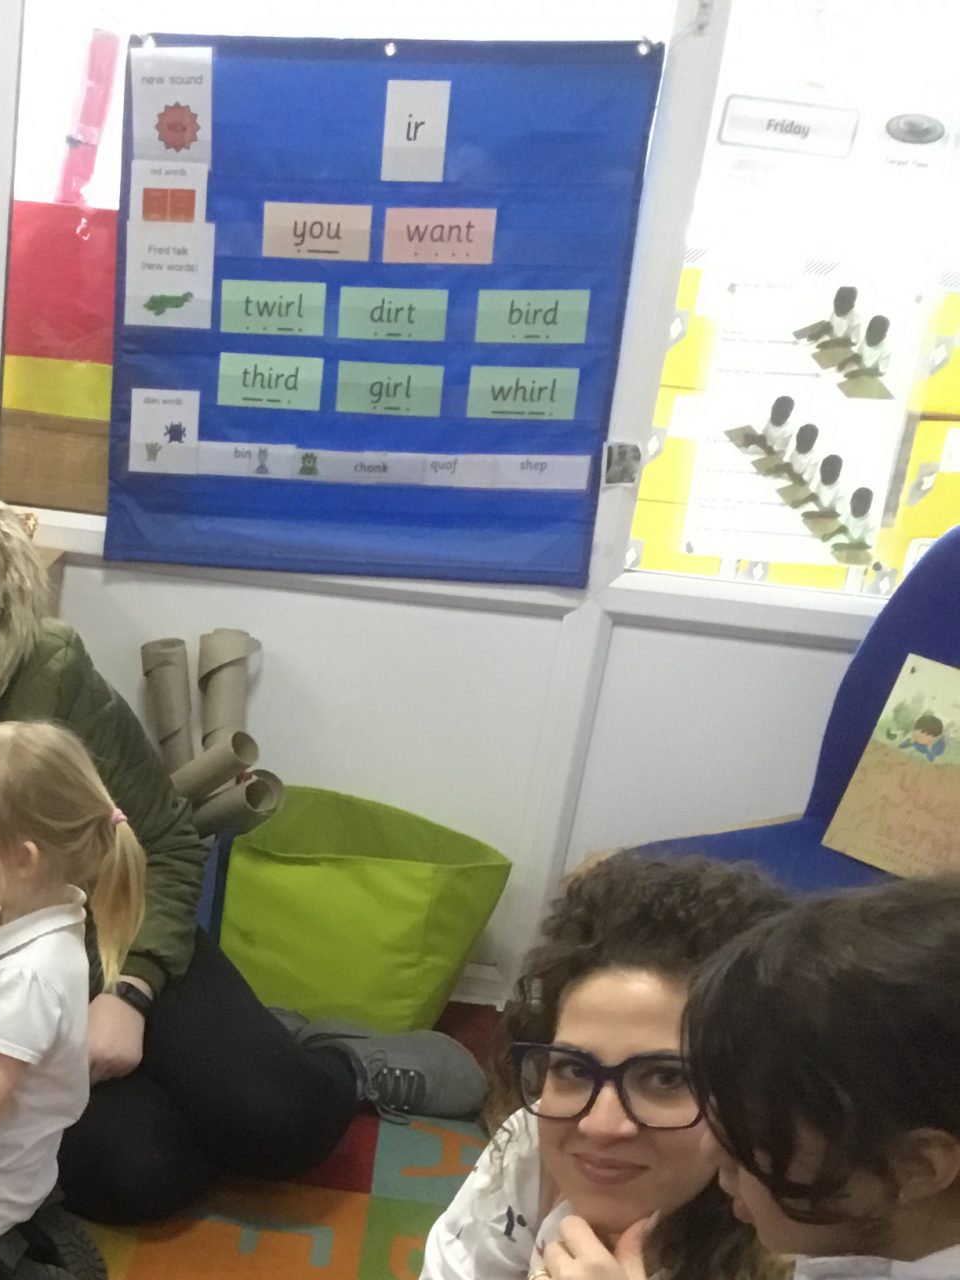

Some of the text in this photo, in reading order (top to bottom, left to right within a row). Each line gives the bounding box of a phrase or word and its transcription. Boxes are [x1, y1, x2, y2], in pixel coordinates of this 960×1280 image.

[141, 73, 204, 86] new sound
[405, 113, 426, 141] ir
[765, 117, 811, 140] Friday
[292, 219, 342, 247] you
[406, 220, 476, 243] want
[148, 244, 189, 256] Fred talk
[244, 293, 304, 318] twirl
[370, 298, 416, 324] dirt
[508, 300, 559, 325] bird
[242, 364, 299, 391] third
[369, 375, 412, 403] girl
[490, 378, 557, 402] whirl
[353, 460, 389, 474] chonk
